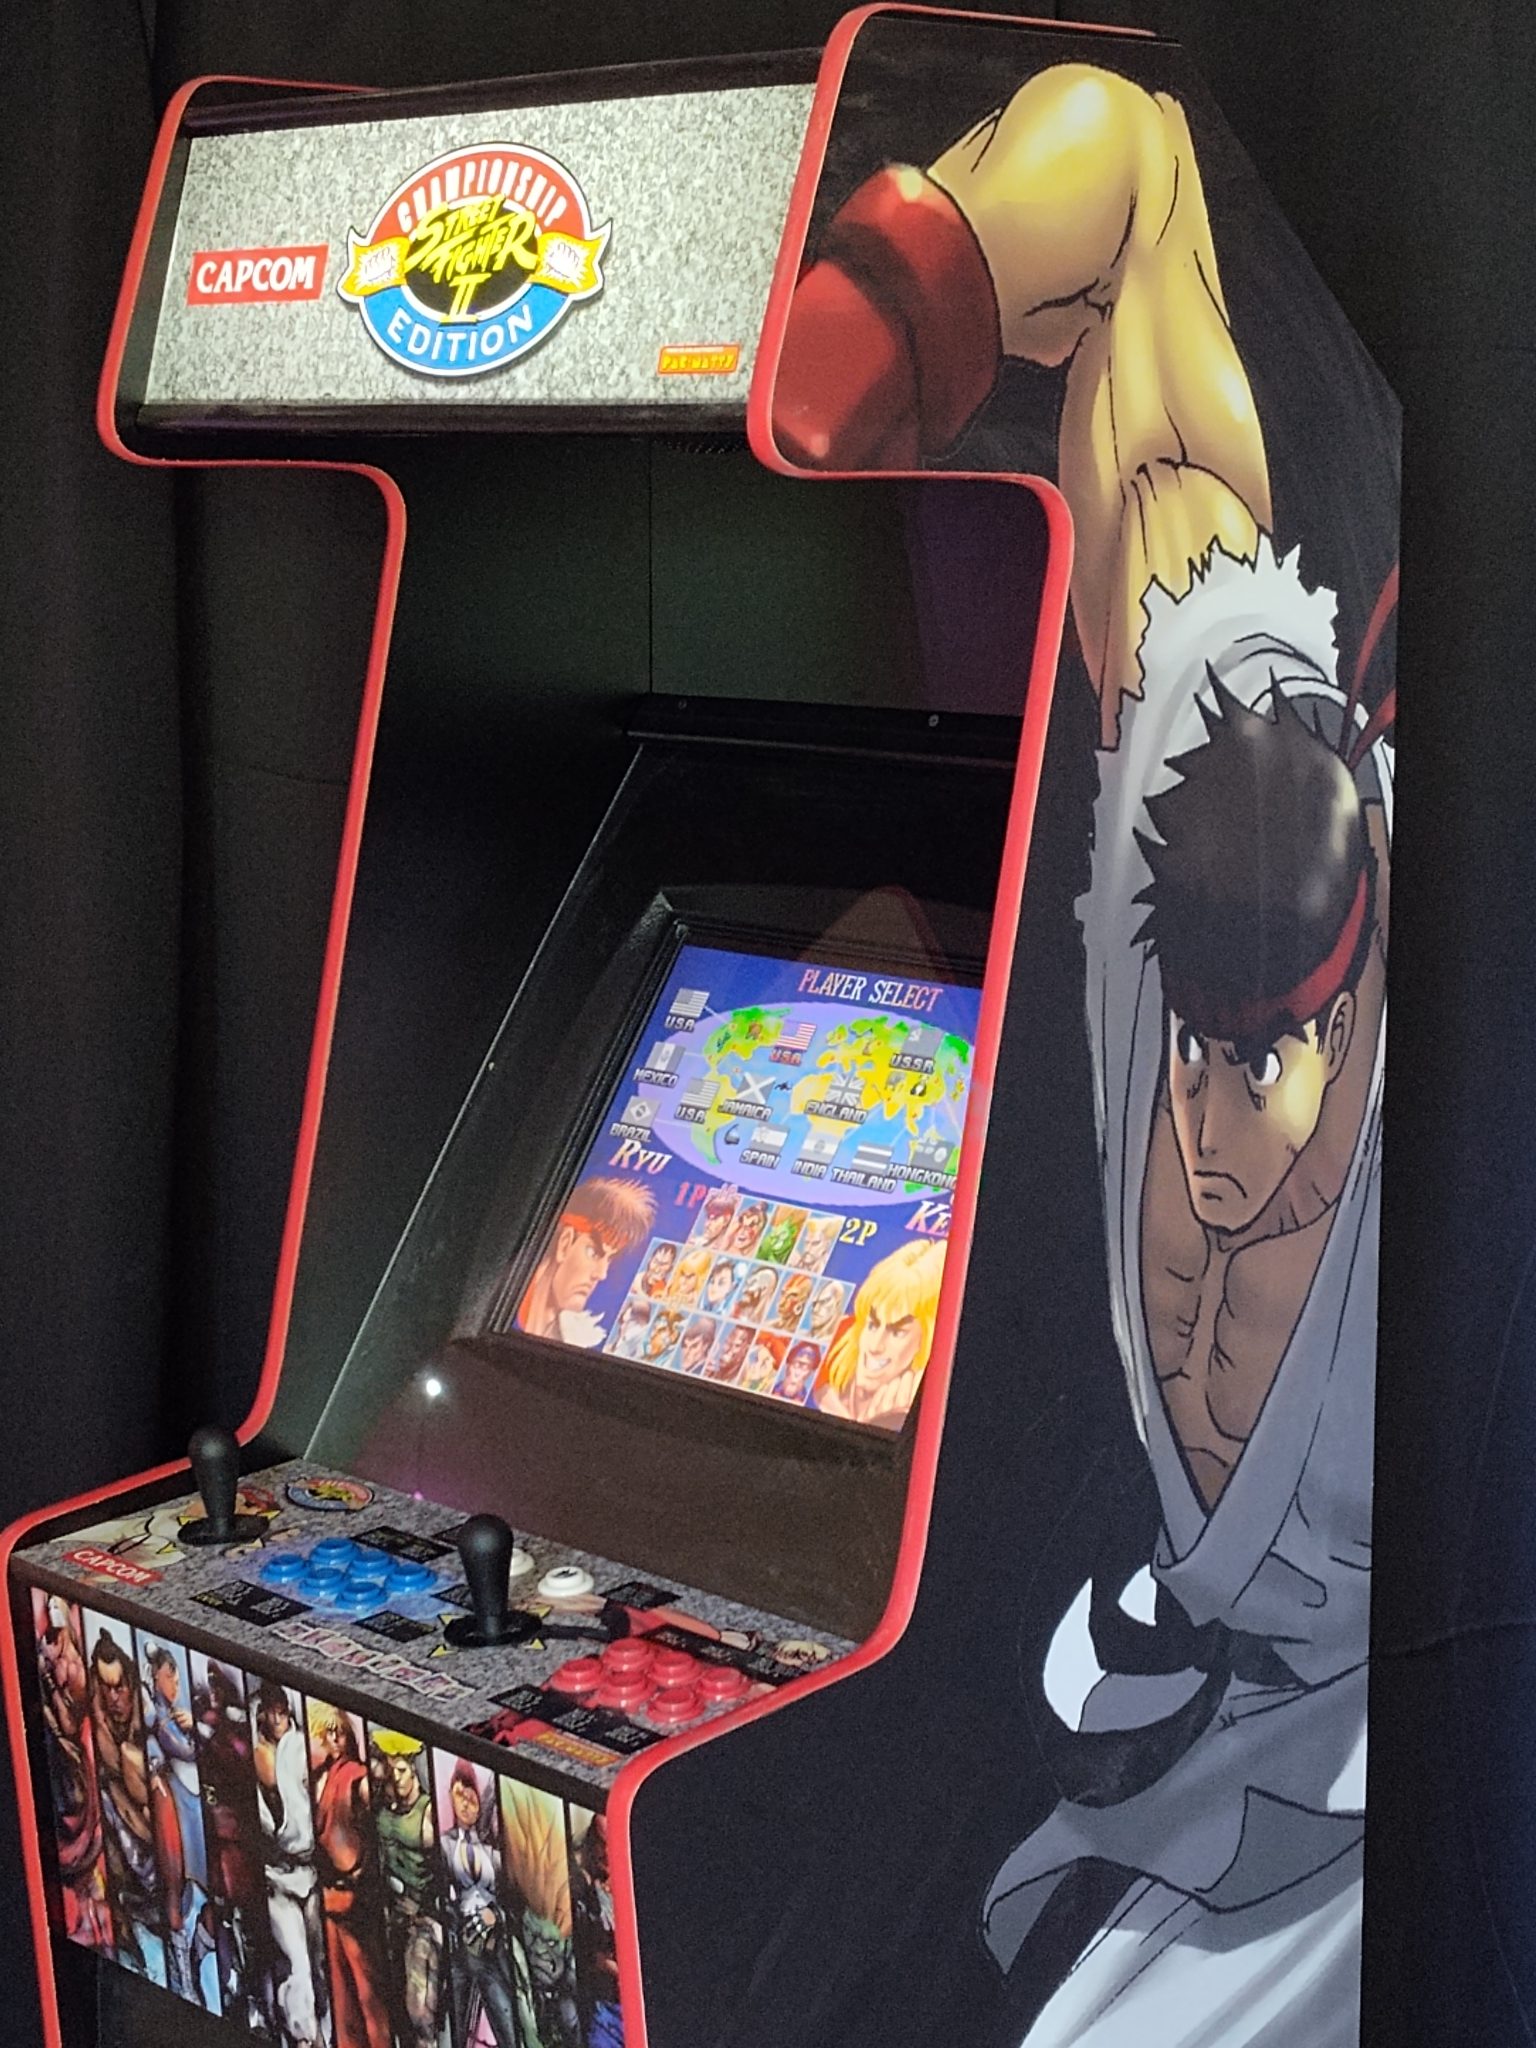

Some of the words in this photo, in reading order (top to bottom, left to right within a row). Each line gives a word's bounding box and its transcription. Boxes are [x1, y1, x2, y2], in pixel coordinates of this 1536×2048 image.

[397, 158, 567, 233] CHAMPIONSHIP
[404, 193, 506, 274] STREET
[418, 211, 539, 284] FIGHTER
[196, 256, 316, 294] CAPCOM
[387, 303, 533, 362] EDITION
[798, 969, 867, 1000] PLAYER
[868, 980, 943, 1012] SELECT
[665, 1015, 696, 1032] USA
[769, 1050, 801, 1065] USA
[891, 1053, 934, 1073] USSR
[634, 1068, 678, 1087] MEXICO
[675, 1106, 706, 1123] USA
[719, 1099, 772, 1121] JAMAICA
[805, 1101, 867, 1123] ENGLAND
[610, 1123, 651, 1141] BRAZIL
[740, 1150, 781, 1169] SPAIN
[792, 1160, 827, 1178] INDIA
[831, 1168, 897, 1193] THAILAND
[674, 1181, 708, 1209] 1P
[905, 1200, 952, 1237] KE
[839, 1217, 878, 1246] 2P
[73, 1549, 151, 1583] CAPCOM
